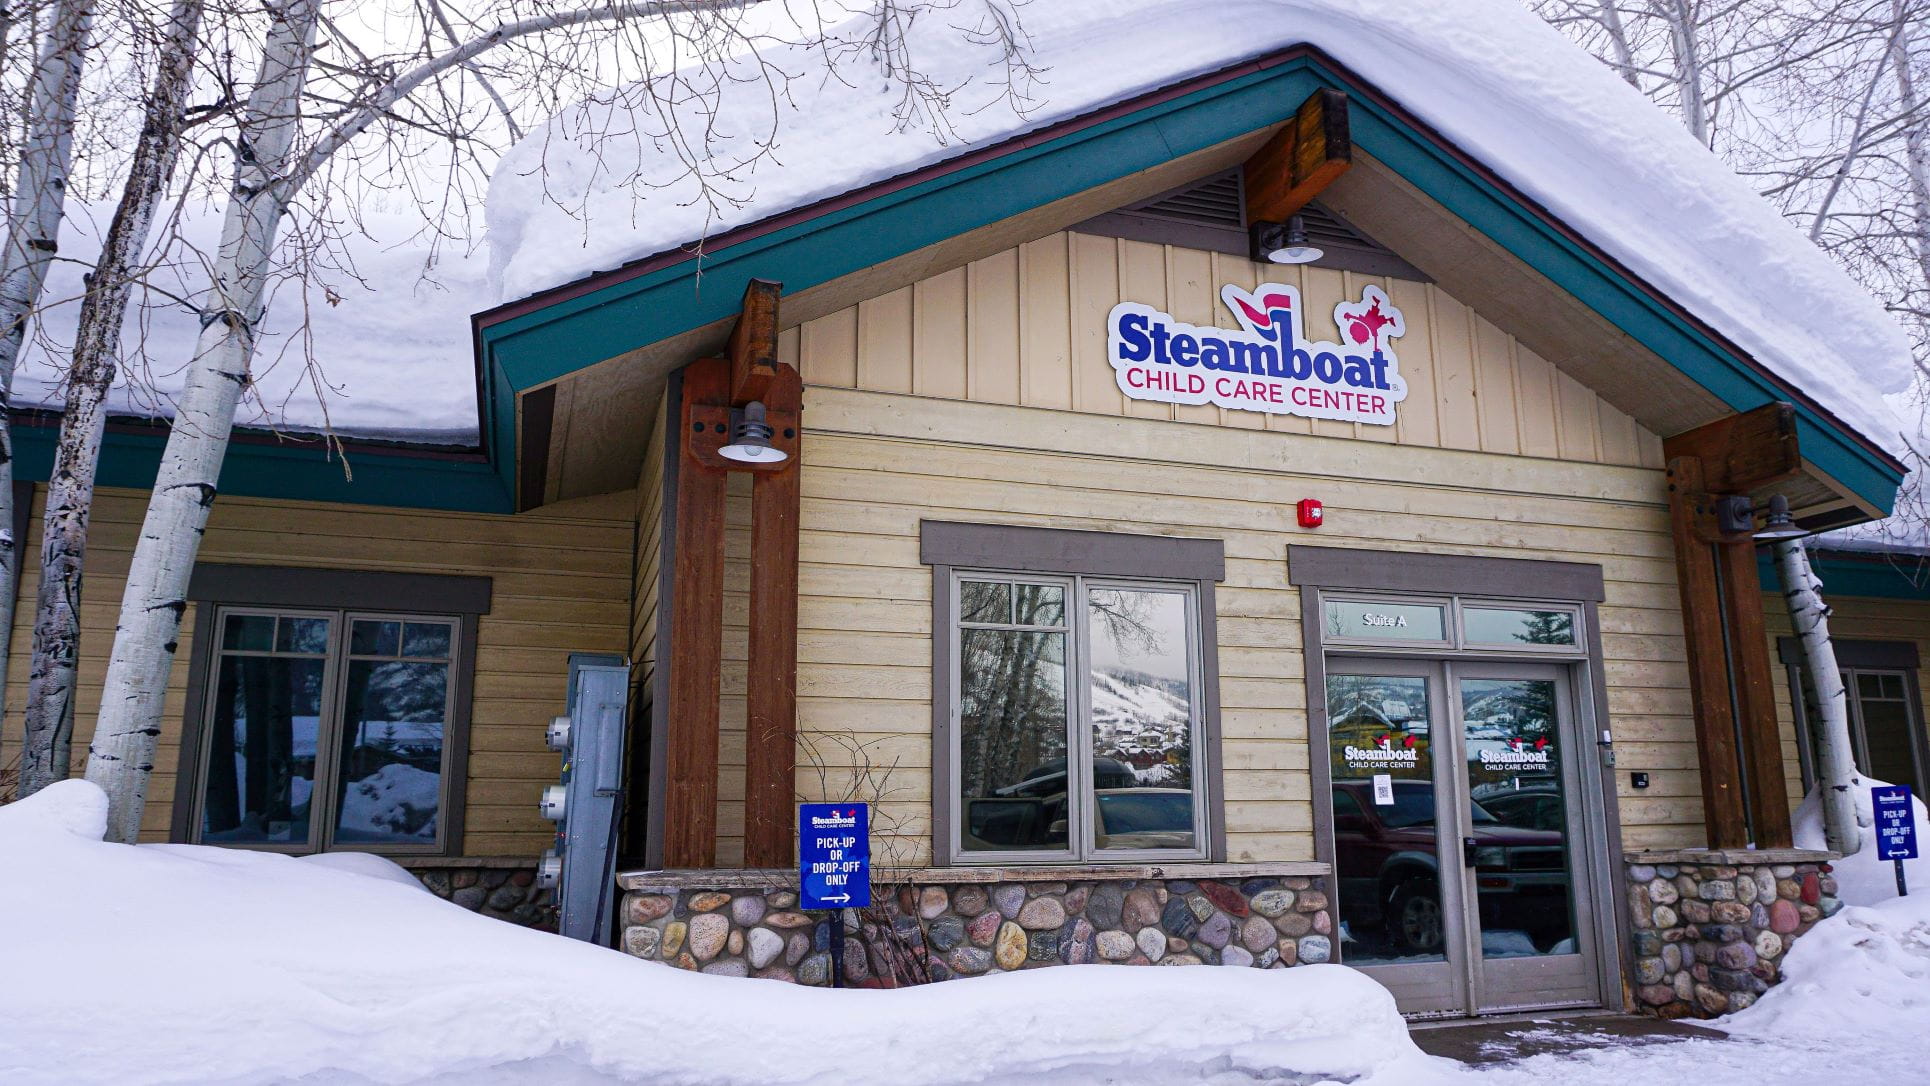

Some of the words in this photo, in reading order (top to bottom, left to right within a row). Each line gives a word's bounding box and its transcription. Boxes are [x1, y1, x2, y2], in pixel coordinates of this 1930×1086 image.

[1119, 310, 1390, 390] Steamboat
[1127, 368, 1205, 393] CHILD
[1216, 378, 1283, 404] CARE
[1291, 386, 1386, 415] CENTER
[1364, 613, 1395, 626] Suite
[1397, 615, 1407, 626] A
[1345, 740, 1417, 760] Steamboat
[1481, 743, 1547, 762] Steamboat
[812, 813, 855, 824] Steamboat
[1883, 810, 1907, 818] PICK-UP
[1883, 827, 1910, 836] DROP-OFF
[816, 837, 855, 848] PICK-UP
[1891, 836, 1904, 844] ONLY
[830, 850, 842, 860] OR
[813, 861, 860, 873] DROP-OFF
[826, 874, 848, 885] ONLY
